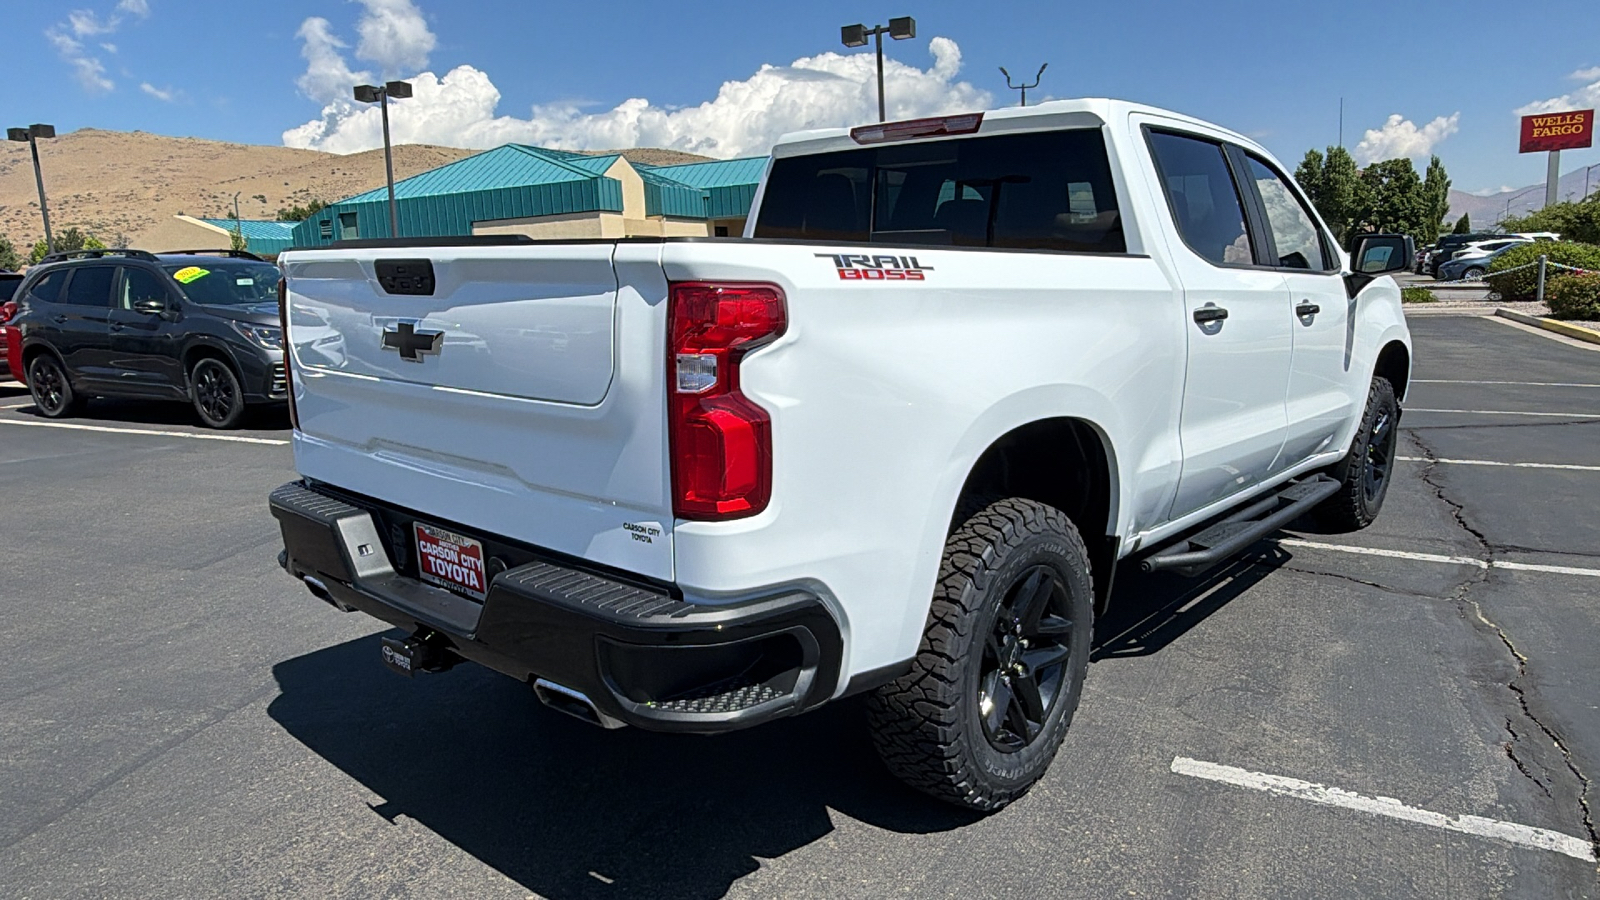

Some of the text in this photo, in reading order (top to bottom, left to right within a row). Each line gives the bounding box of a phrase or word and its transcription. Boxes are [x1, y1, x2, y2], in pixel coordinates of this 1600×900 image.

[1532, 114, 1584, 127] WELLS
[1532, 125, 1583, 137] FARGO
[813, 253, 935, 271] TRAIL
[837, 269, 925, 280] BOSS
[623, 522, 660, 537] CARSON CITY
[631, 533, 652, 544] TOYOTA
[420, 540, 481, 572] CARSON CITY
[428, 556, 479, 589] TOYOTA
